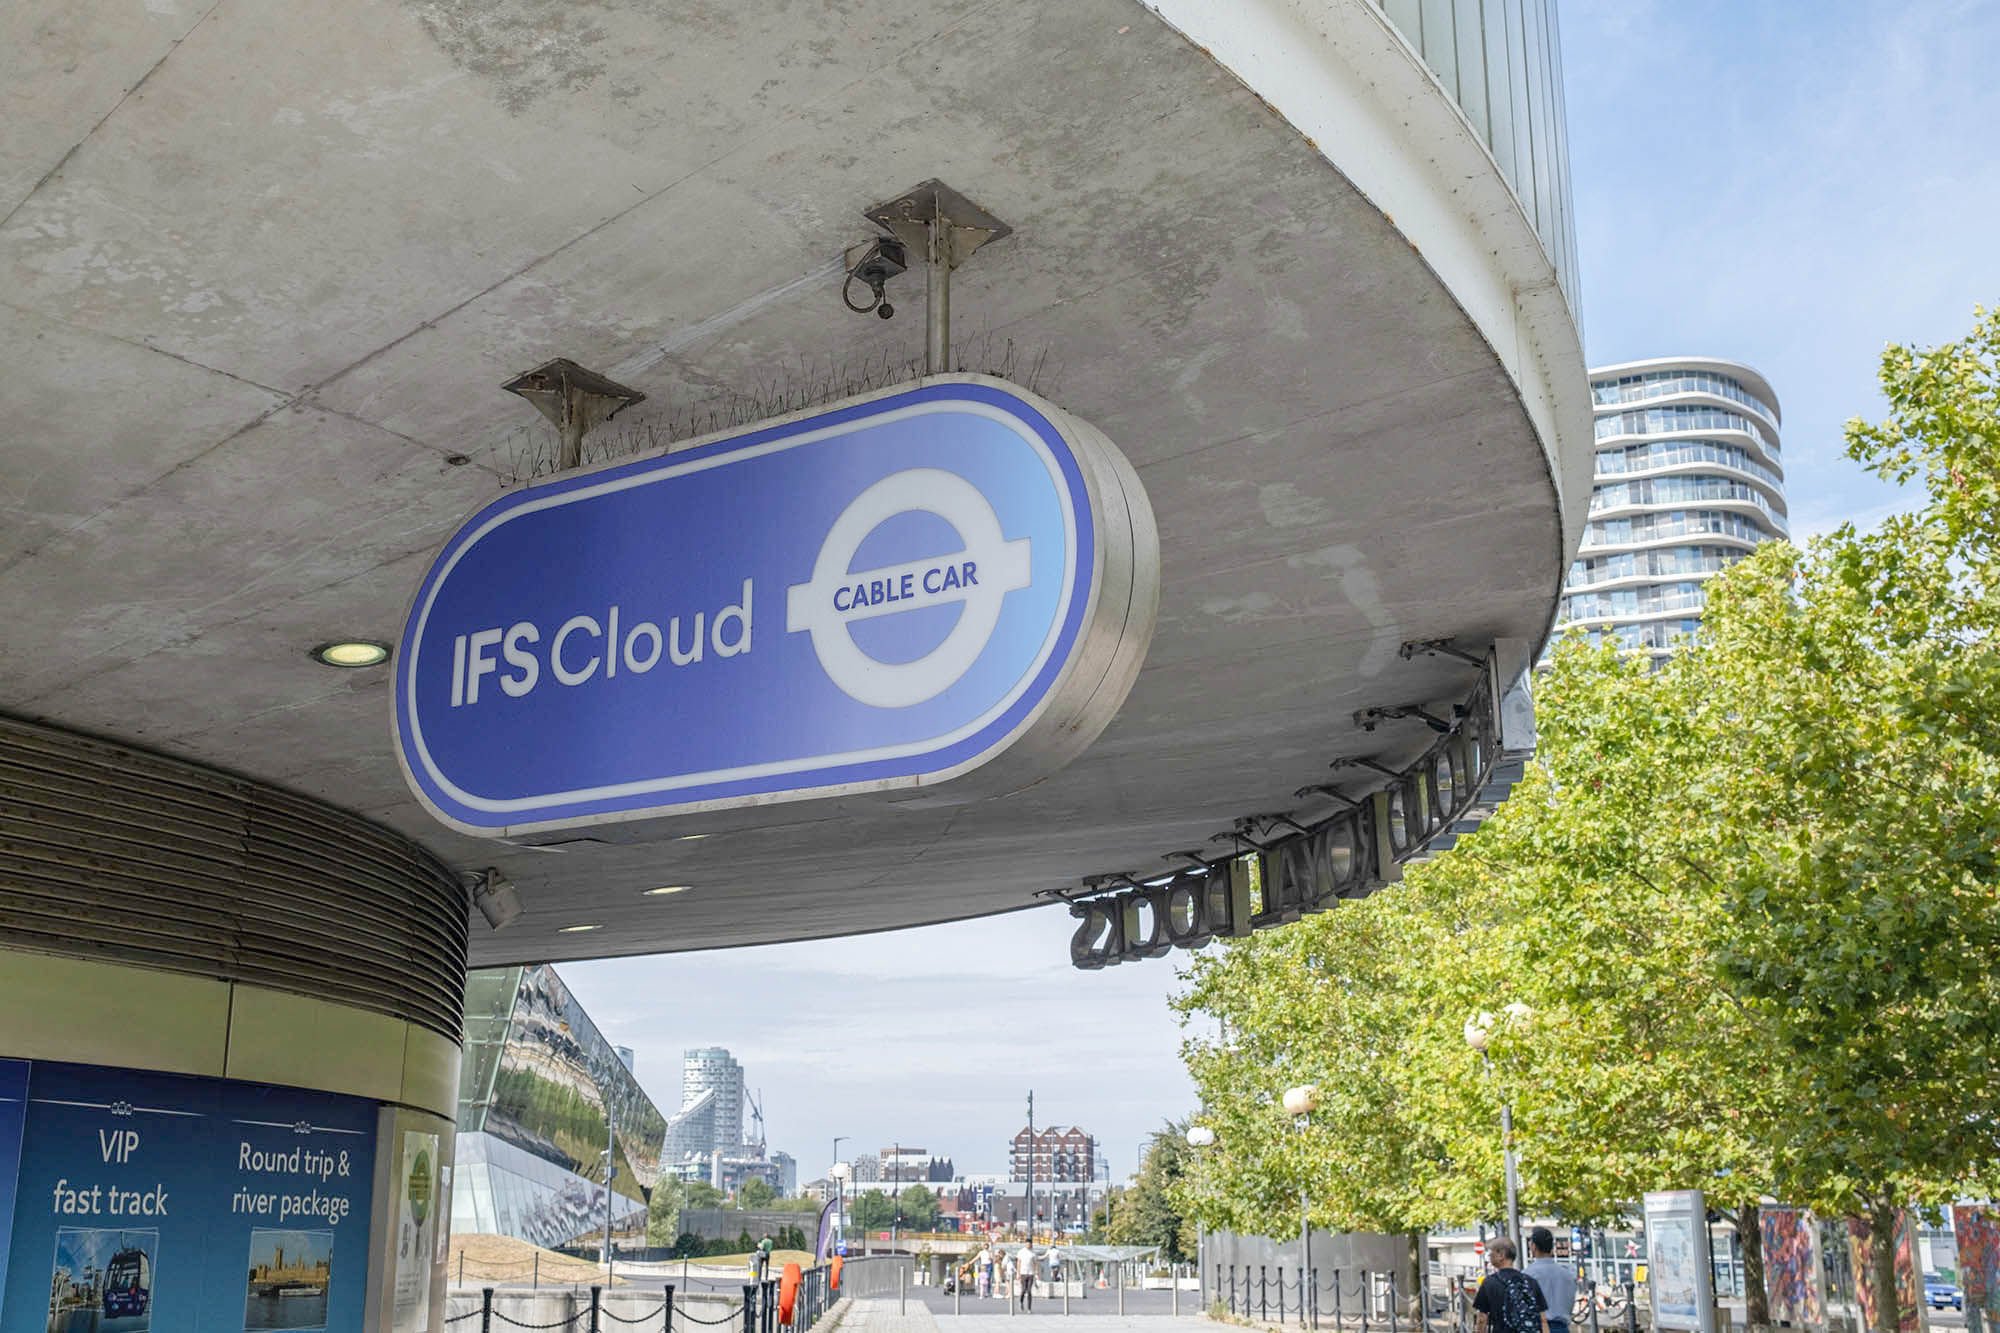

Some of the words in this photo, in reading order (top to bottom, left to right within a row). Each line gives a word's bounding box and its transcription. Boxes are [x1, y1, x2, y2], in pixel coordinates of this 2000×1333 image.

[833, 573, 914, 612] CABLE
[922, 561, 979, 594] CAR
[99, 1128, 140, 1163] VIP
[239, 1142, 300, 1173] Round
[303, 1149, 334, 1183] trip
[337, 1150, 351, 1177] &
[53, 1179, 102, 1214] fast
[108, 1183, 169, 1216] track
[232, 1186, 278, 1214] river
[279, 1188, 350, 1225] package
